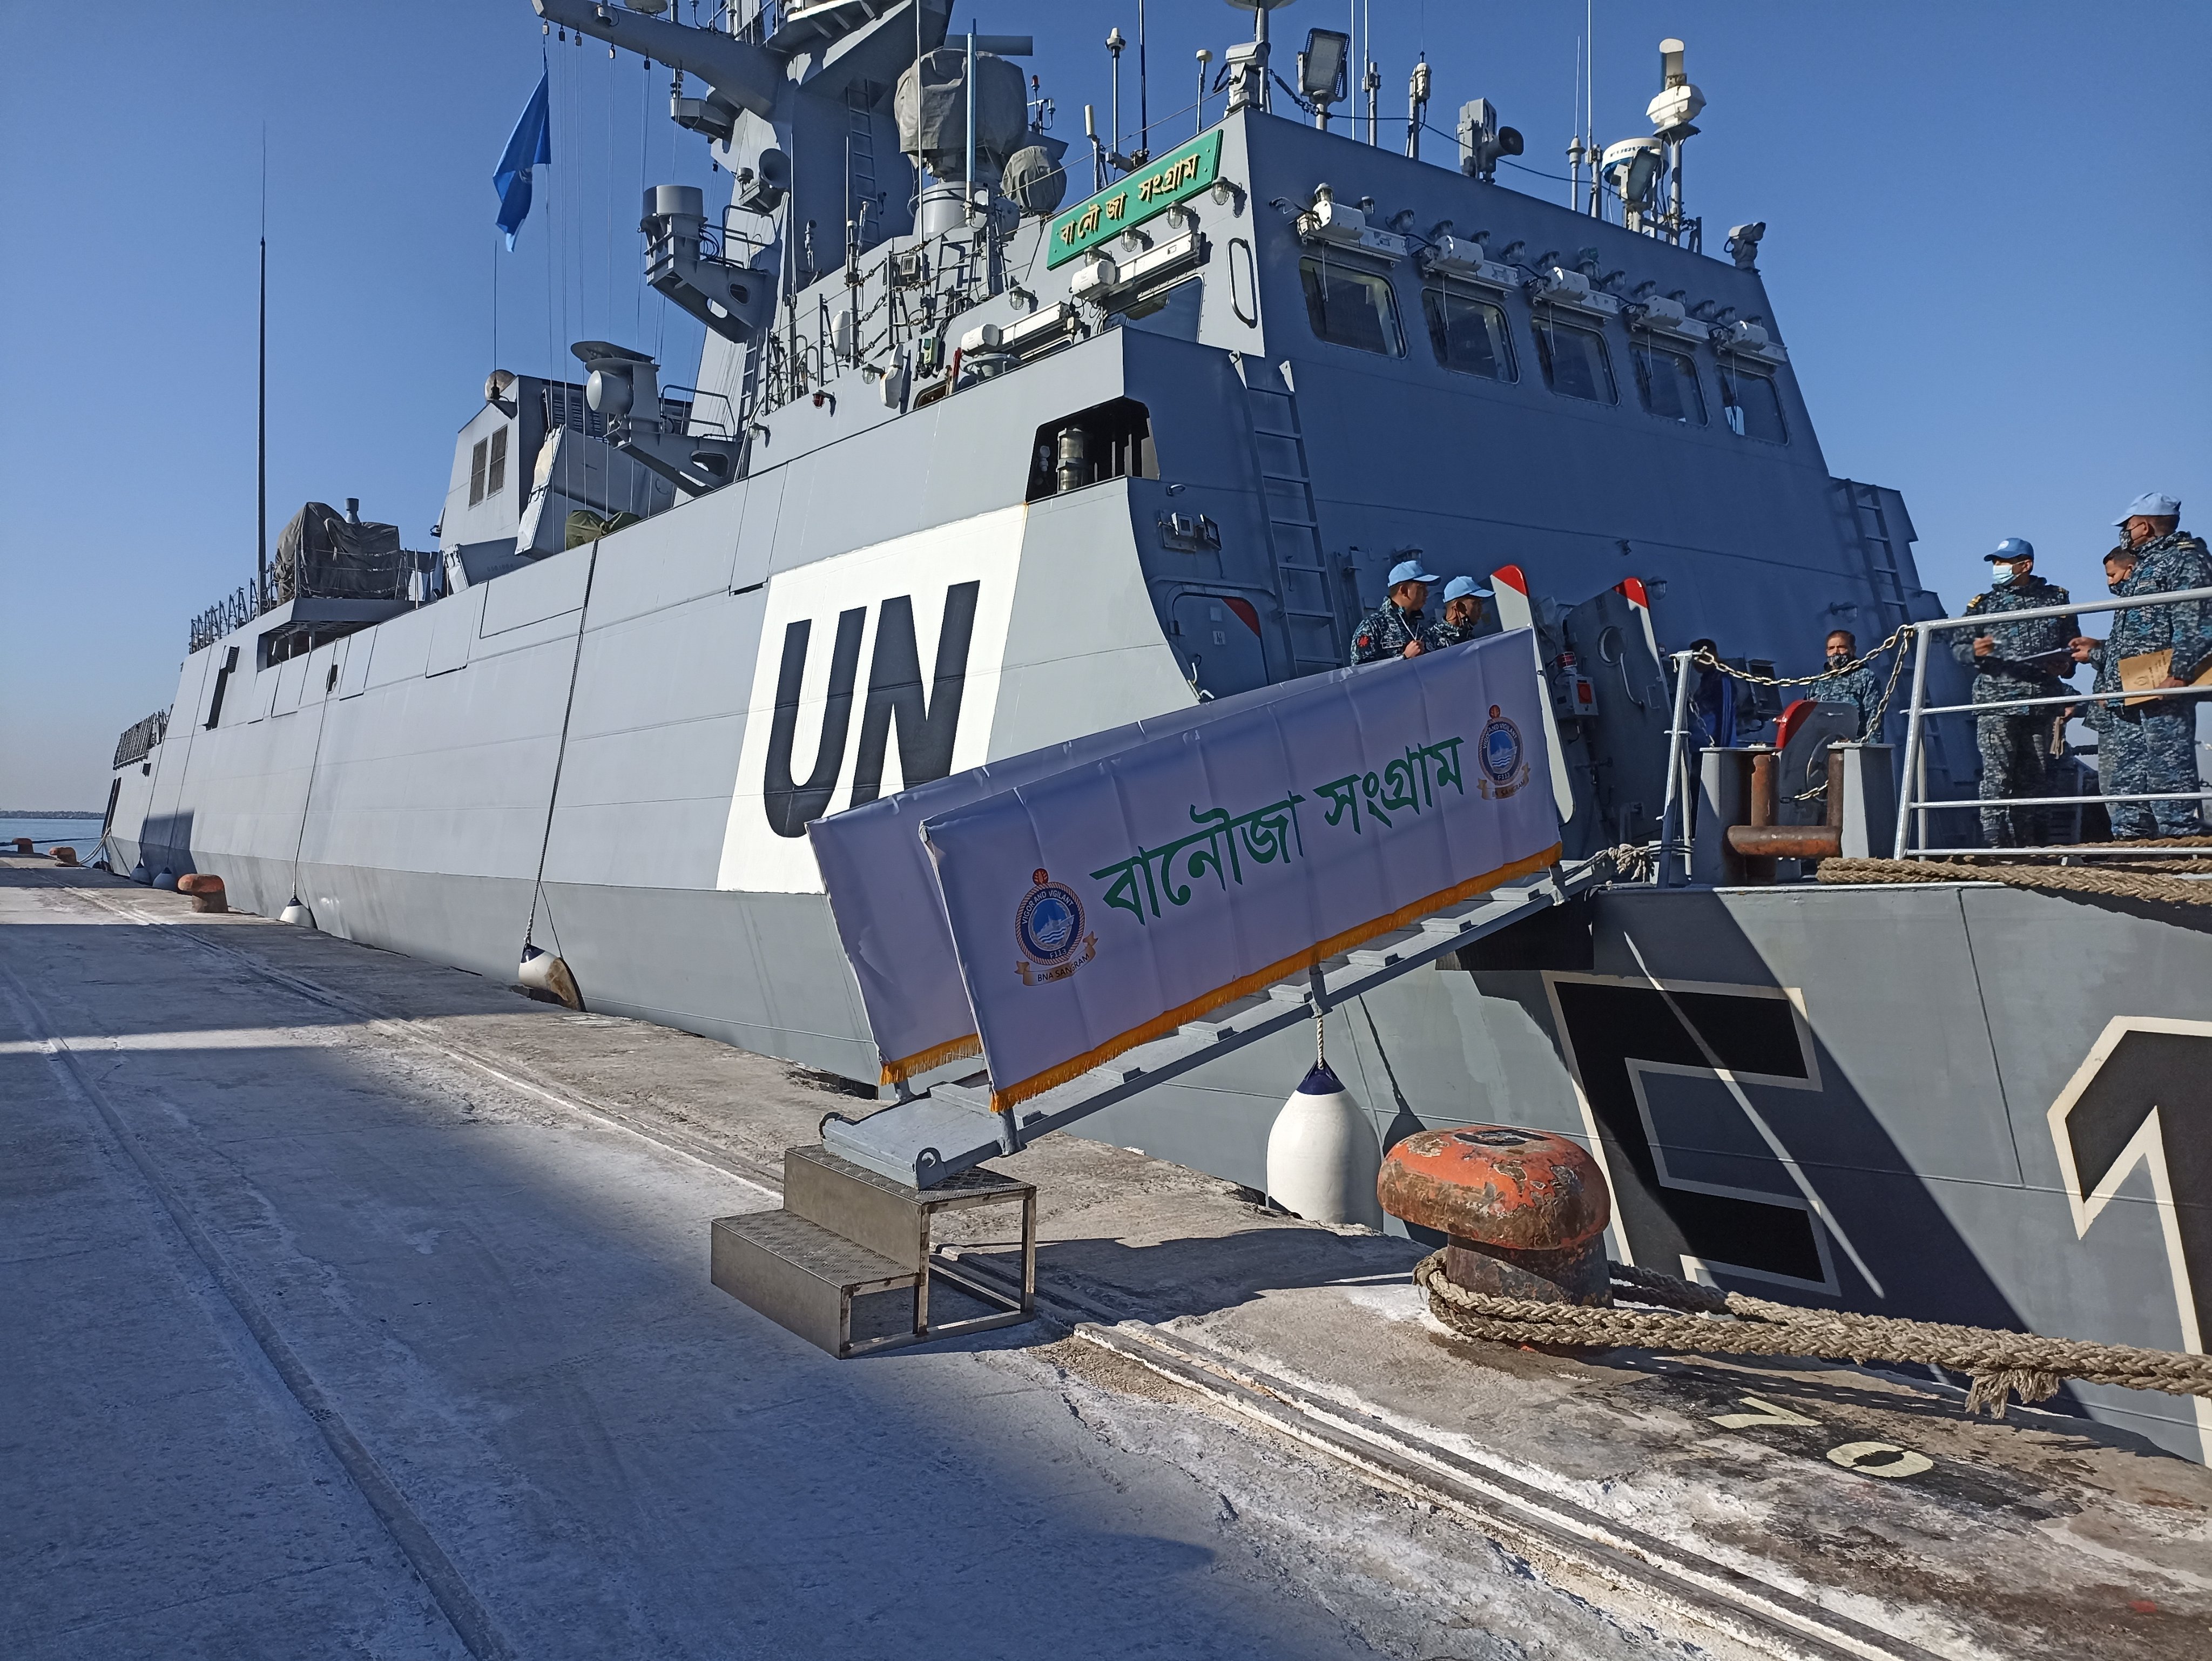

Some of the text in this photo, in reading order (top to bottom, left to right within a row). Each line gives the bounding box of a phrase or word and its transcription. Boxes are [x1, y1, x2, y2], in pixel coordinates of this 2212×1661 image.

[1137, 153, 1200, 204] সংগ্রাম
[764, 580, 980, 838] UN
[1089, 736, 1464, 926] বানৌজা সংগ্রাম
[1022, 889, 1074, 924] VIGOR AND VIGILANT
[1037, 953, 1090, 982] BNA SANGRAM
[1049, 948, 1067, 959] F113
